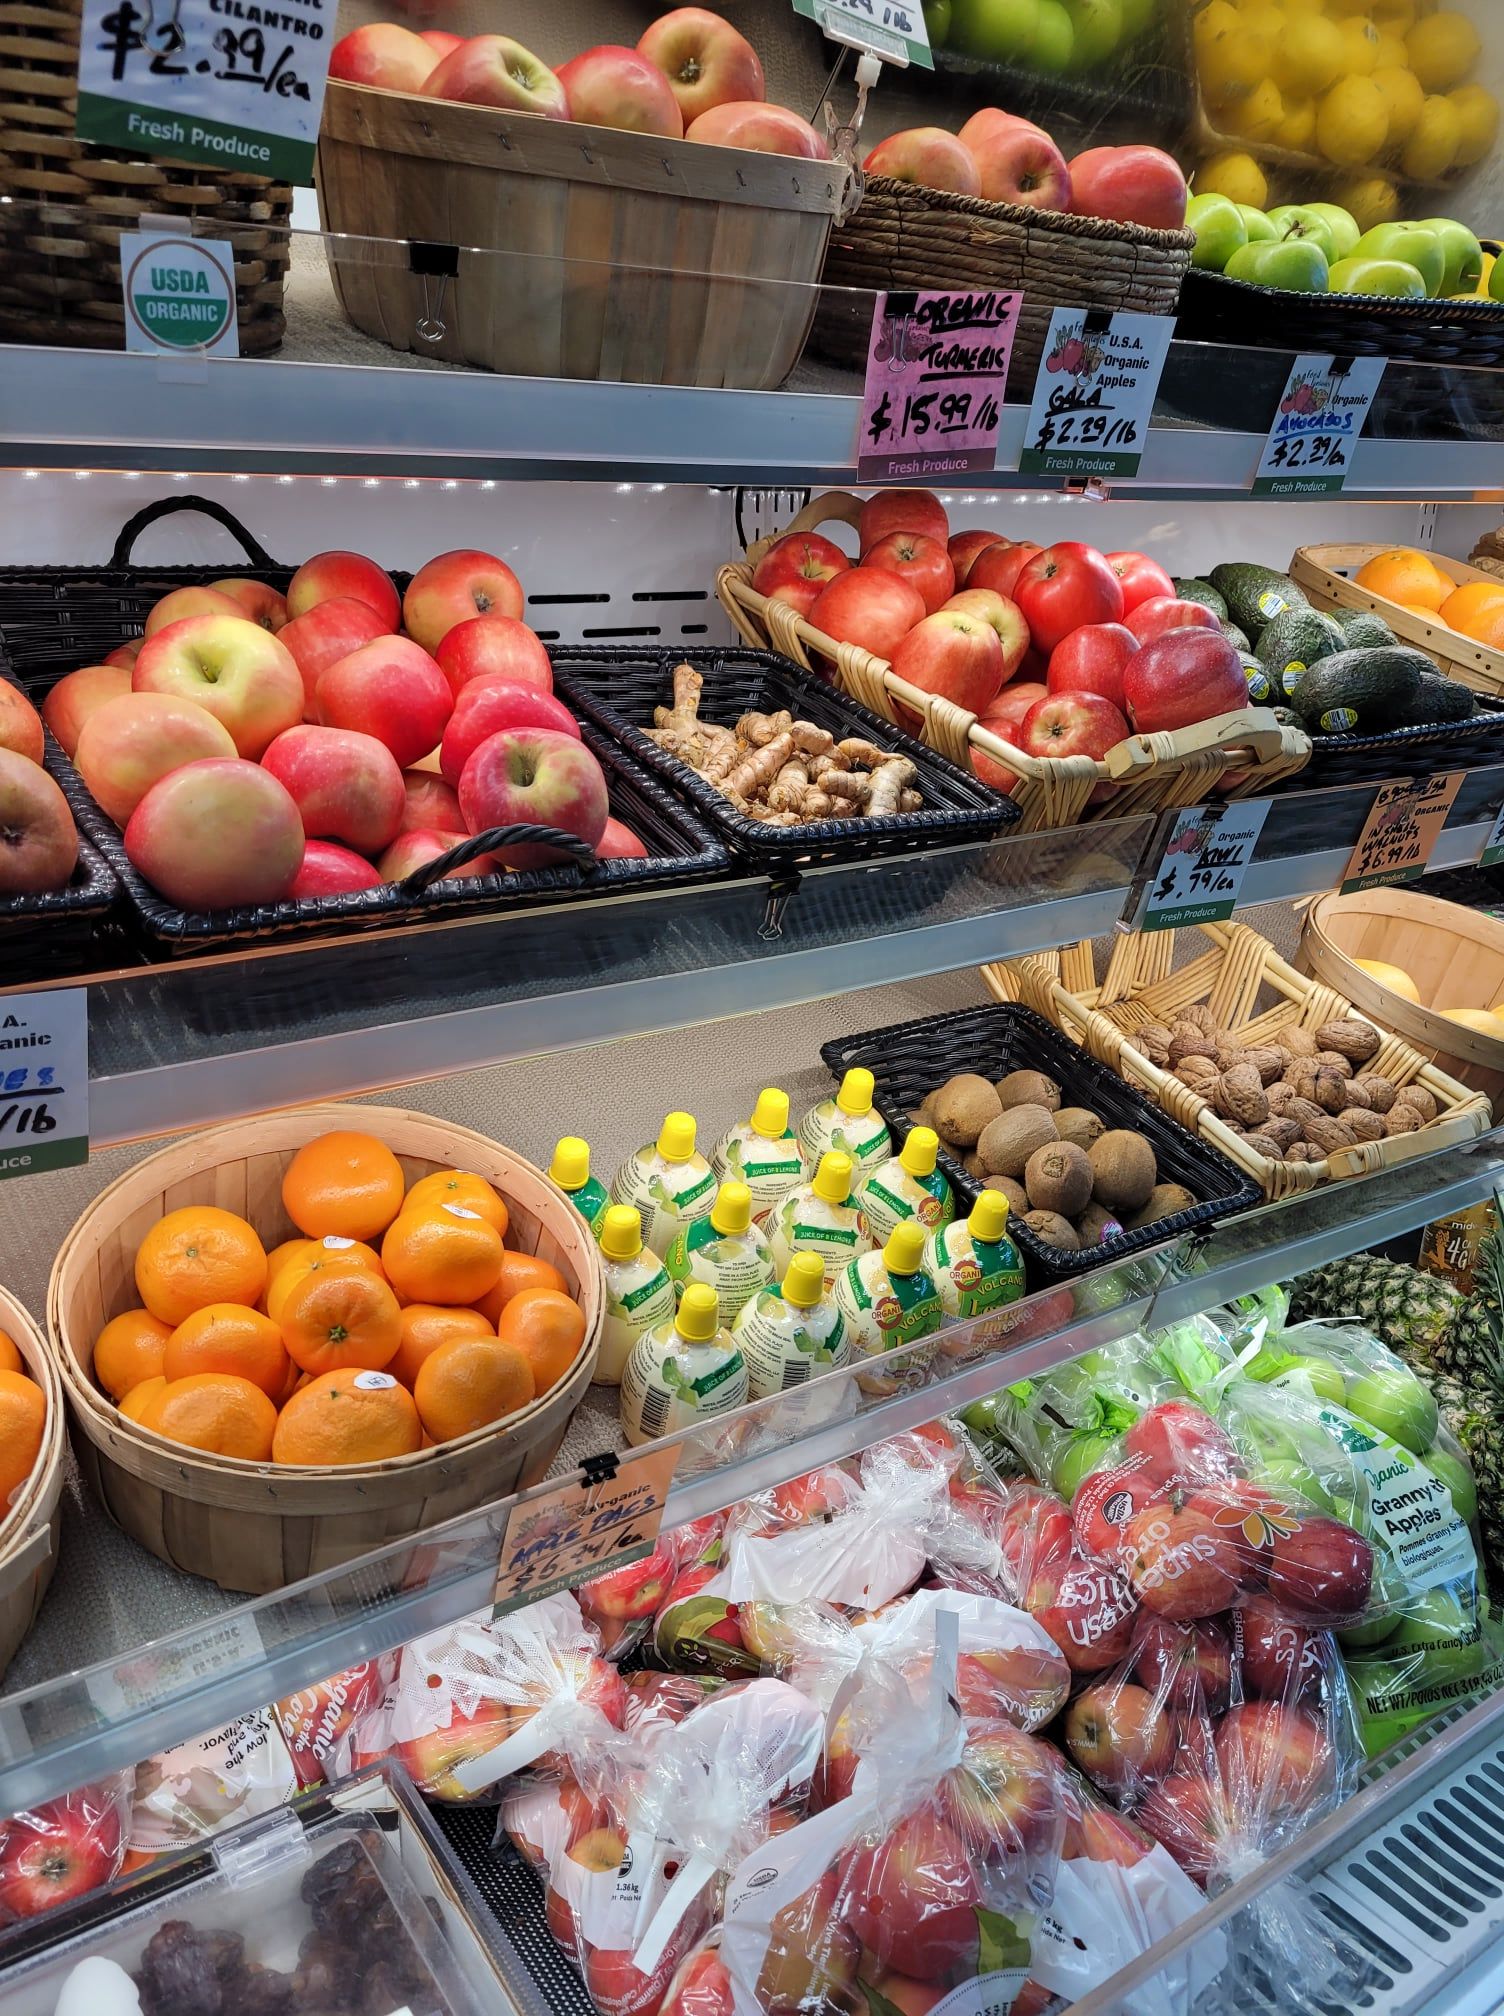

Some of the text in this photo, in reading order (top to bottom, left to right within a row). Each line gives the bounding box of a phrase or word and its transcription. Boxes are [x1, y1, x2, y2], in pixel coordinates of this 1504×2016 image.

[210, 0, 324, 41] CILANTRO
[128, 113, 271, 162] Fresh Produce
[151, 267, 210, 294] USDA
[146, 301, 218, 322] ORGANIC
[1109, 334, 1143, 350] U.S.A.
[1103, 355, 1150, 370] Organic
[1095, 373, 1137, 389] Apples
[1331, 394, 1369, 407] Organic
[888, 457, 968, 475] Fresh Produce
[1046, 456, 1116, 472] Fresh Produce
[1270, 481, 1327, 493] Fresh Produce
[1217, 829, 1255, 842] Organic
[1199, 844, 1244, 866] KIWI
[1359, 872, 1407, 888] Fresh Produce
[1159, 905, 1217, 924] Fresh Produce
[800, 1231, 815, 1239] JUICE
[703, 1380, 717, 1392] JUICE
[1371, 1484, 1434, 1516] Granny
[1115, 1499, 1128, 1521] USDA
[1384, 1507, 1442, 1536] Apples
[1399, 1537, 1427, 1554] Pommes
[1426, 1527, 1451, 1543] Granny
[1401, 1544, 1444, 1567] biologiques
[528, 1579, 565, 1601] Fresh
[568, 1556, 625, 1583] Produce
[1411, 1641, 1436, 1653] Extra
[1437, 1638, 1463, 1652] Fancy
[225, 1733, 268, 1769] low the
[295, 1730, 312, 1753] the
[616, 1883, 639, 1893] 1.36 kg
